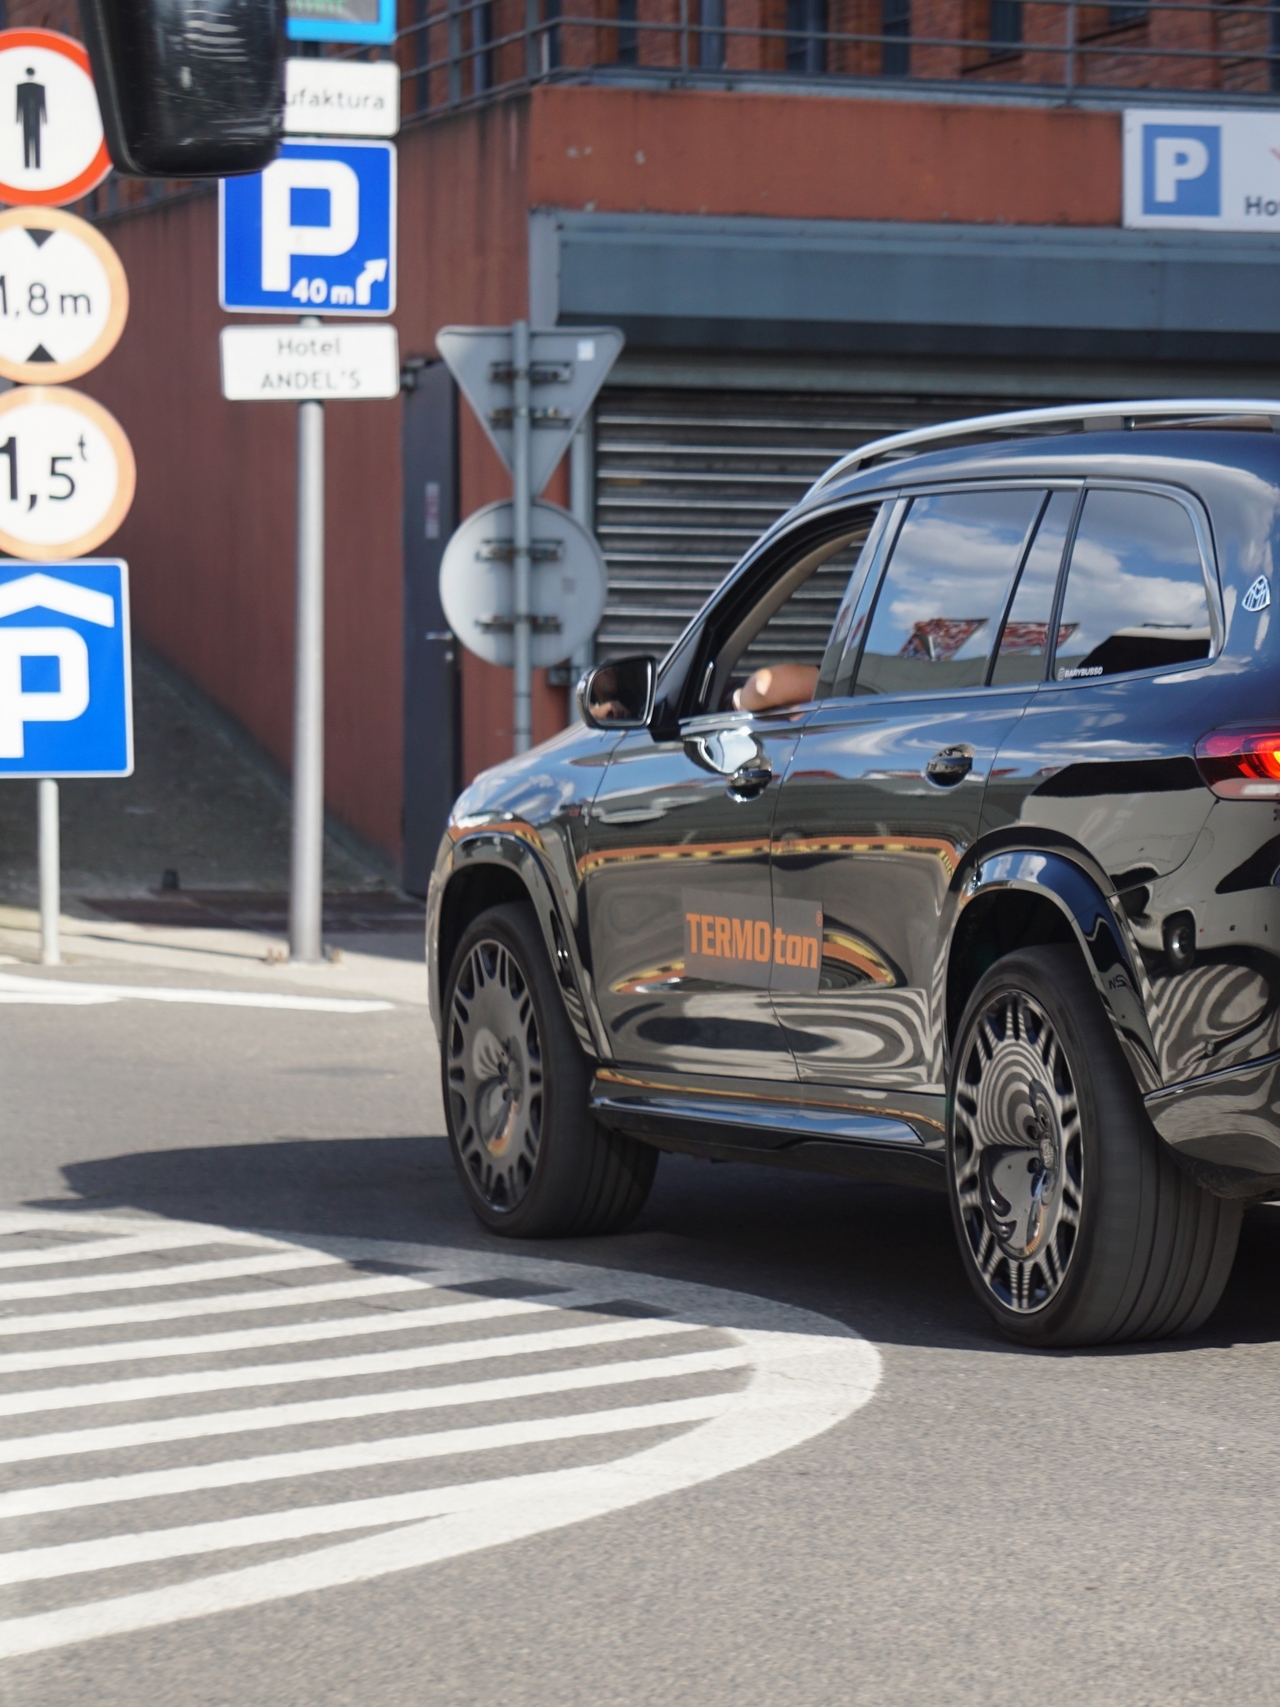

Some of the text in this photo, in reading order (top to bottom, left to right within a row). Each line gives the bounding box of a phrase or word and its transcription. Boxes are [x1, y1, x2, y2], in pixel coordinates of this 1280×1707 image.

[1154, 138, 1208, 202] P
[261, 158, 359, 292] P
[277, 338, 341, 357] Hotel
[261, 373, 361, 392] ANDEL'S
[0, 436, 76, 512] 1,5
[685, 912, 819, 970] TERMOton
